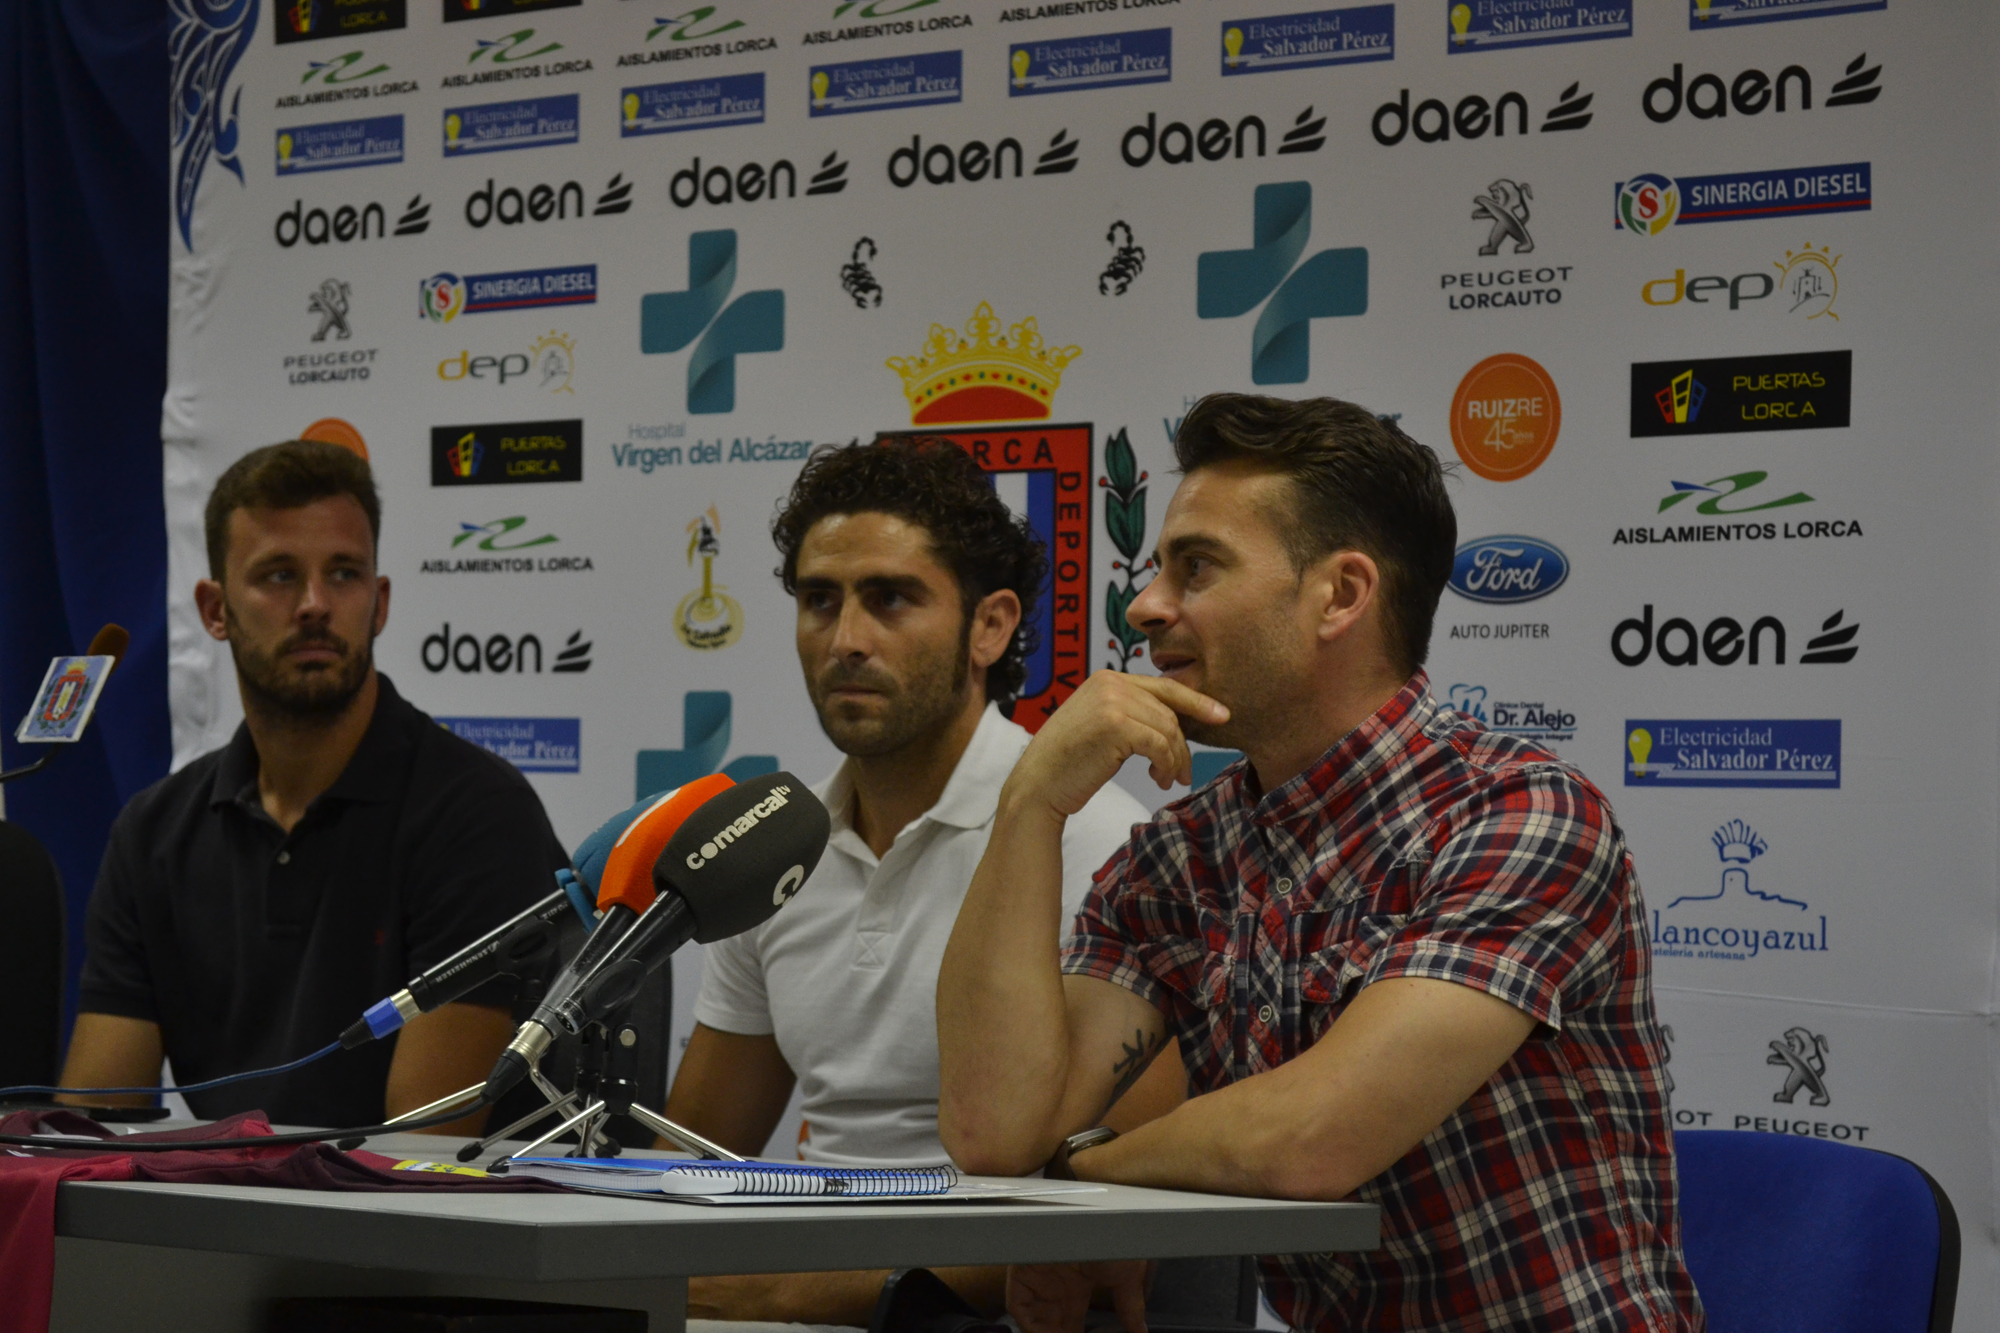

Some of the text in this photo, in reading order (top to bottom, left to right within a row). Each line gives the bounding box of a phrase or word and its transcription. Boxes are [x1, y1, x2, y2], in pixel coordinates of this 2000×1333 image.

[999, 0, 1118, 22] AISLAMIENTOS
[1492, 6, 1626, 33] Salvador Pérez
[803, 14, 973, 46] AISLAMIENTOS LORCA
[1249, 16, 1341, 40] Electricidad
[616, 37, 778, 67] AISLAMIENTOS LORCA
[1034, 39, 1122, 63] Electricidad
[1262, 28, 1389, 57] Salvador Pérez
[441, 59, 594, 89] AISLAMIENTOS LORCA
[833, 61, 915, 85] Electricidad
[1047, 51, 1166, 79] Salvador Pérez
[275, 81, 419, 109] AISLAMIENTOS LORCA
[642, 84, 721, 106] Electricidad
[845, 73, 958, 98] Salvador Pérez
[1643, 63, 1812, 123] daen
[655, 94, 761, 120] Salvador Pérez
[1372, 89, 1528, 146] daen
[475, 120, 535, 140] Salvador
[1122, 113, 1266, 167] daen
[888, 134, 1023, 188] daen
[670, 157, 796, 208] daen
[1691, 173, 1867, 206] SINERGIA DIESEL
[466, 179, 584, 228] daen
[275, 199, 385, 248] daen
[472, 272, 594, 300] SINERGIA DIESEL
[1441, 266, 1573, 289] PEUGEOT
[1641, 269, 1774, 310] dep
[1449, 288, 1562, 311] LORCAUTO
[283, 349, 379, 369] PEUGEOT
[438, 350, 529, 385] dep
[289, 367, 370, 386] LORCAUTO
[1733, 371, 1826, 392] PUERTAS
[1468, 397, 1543, 419] RUIZRE
[1742, 402, 1817, 421] LORCA
[628, 422, 686, 440] Hospital
[1484, 418, 1516, 452] 45
[612, 435, 813, 474] Virgen del Alcázar
[973, 437, 1053, 465] RCA
[507, 460, 561, 476] LORCA
[1613, 520, 1863, 545] AISLAMIENTOS LORCA
[420, 557, 594, 574] AISLAMIENTOS LORCA
[1466, 545, 1542, 591] Ford
[1451, 624, 1549, 640] AUTO JUPITER
[1611, 604, 1785, 667] daen
[422, 622, 542, 673] daen
[1494, 709, 1575, 731] Dr. Alejo
[1659, 727, 1773, 748] Electricidad
[1677, 747, 1833, 771] Salvador Pérez
[686, 787, 789, 871] comarcal
[1652, 909, 1829, 957] lancoyazul
[1734, 1115, 1869, 1141] PEUGEOT
